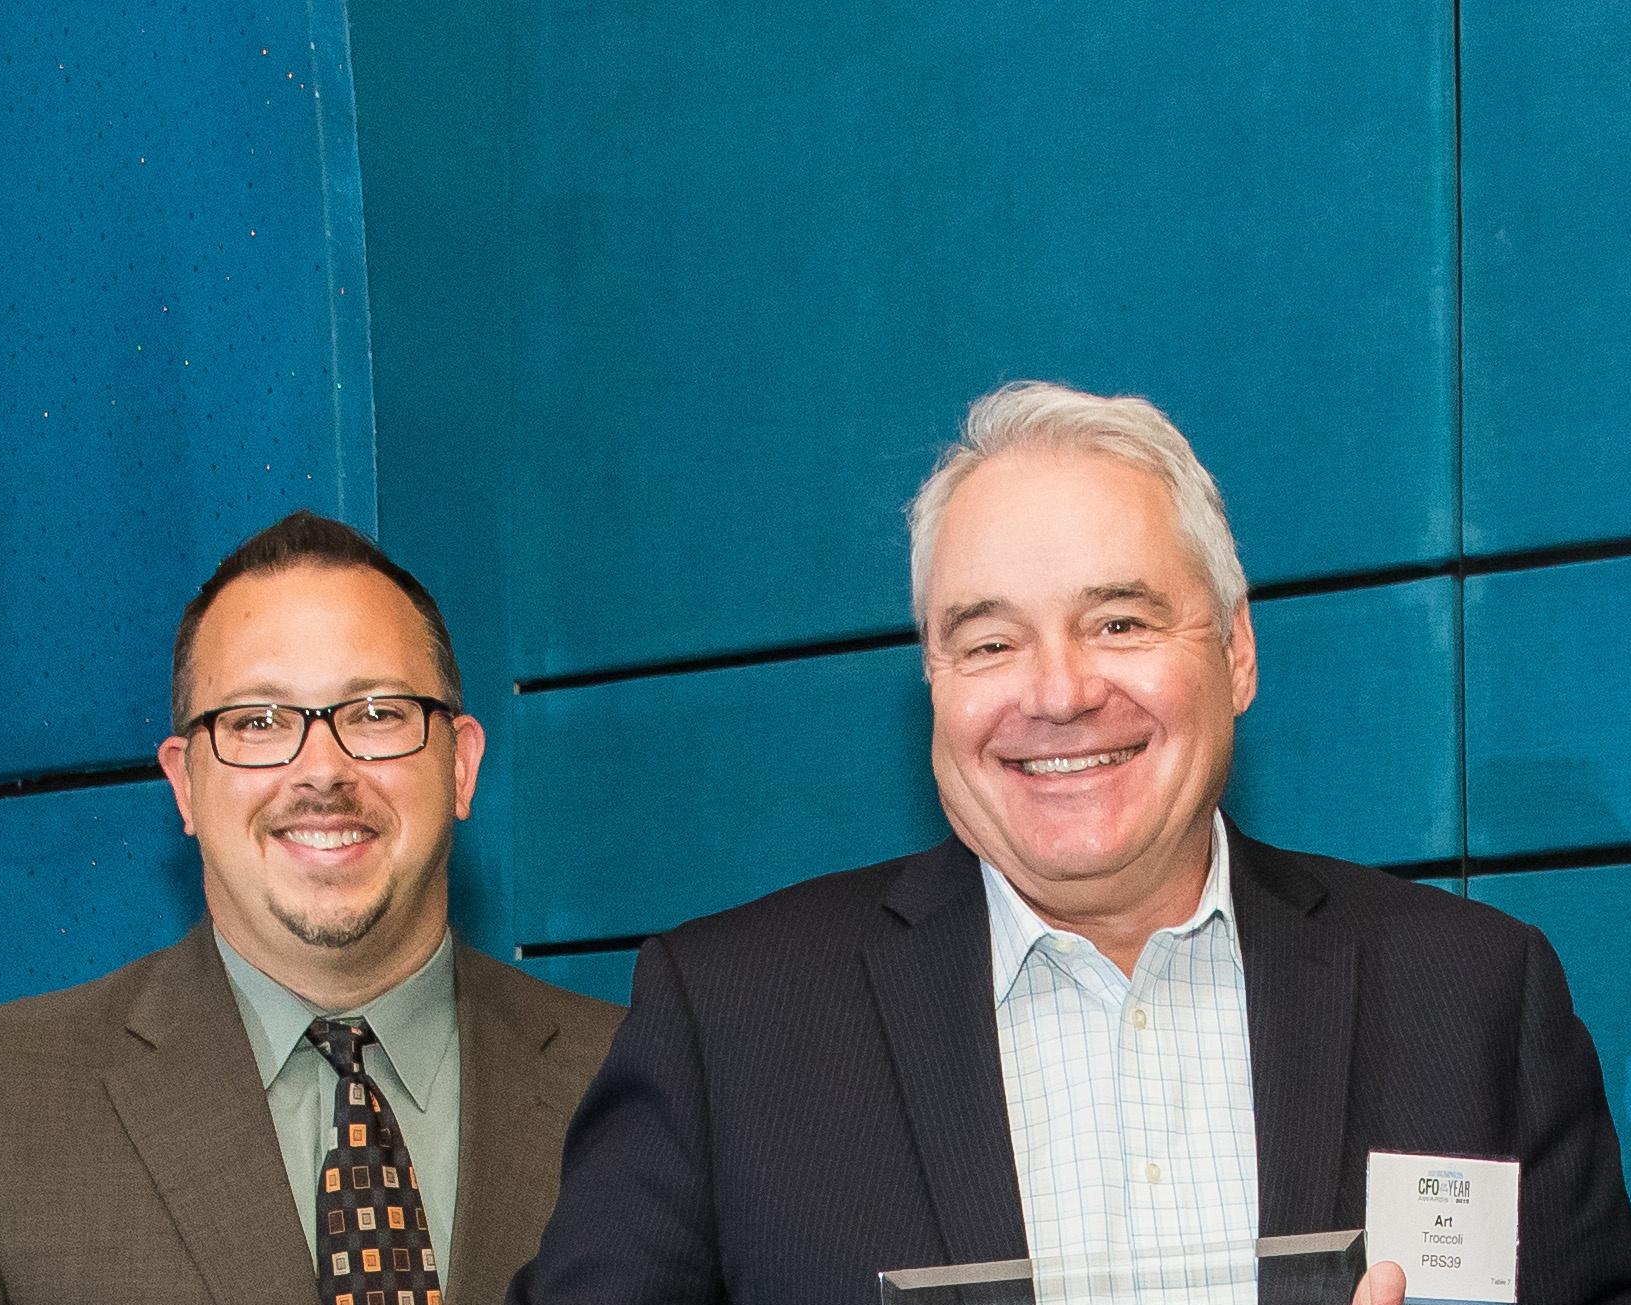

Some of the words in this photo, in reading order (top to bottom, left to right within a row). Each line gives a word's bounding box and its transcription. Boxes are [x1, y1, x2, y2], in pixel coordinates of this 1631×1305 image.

[1418, 1177, 1440, 1195] CFO
[1448, 1179, 1471, 1198] YEAR
[1434, 1214, 1453, 1228] Art
[1421, 1231, 1464, 1246] Troccoli
[1421, 1254, 1462, 1270] PBS39
